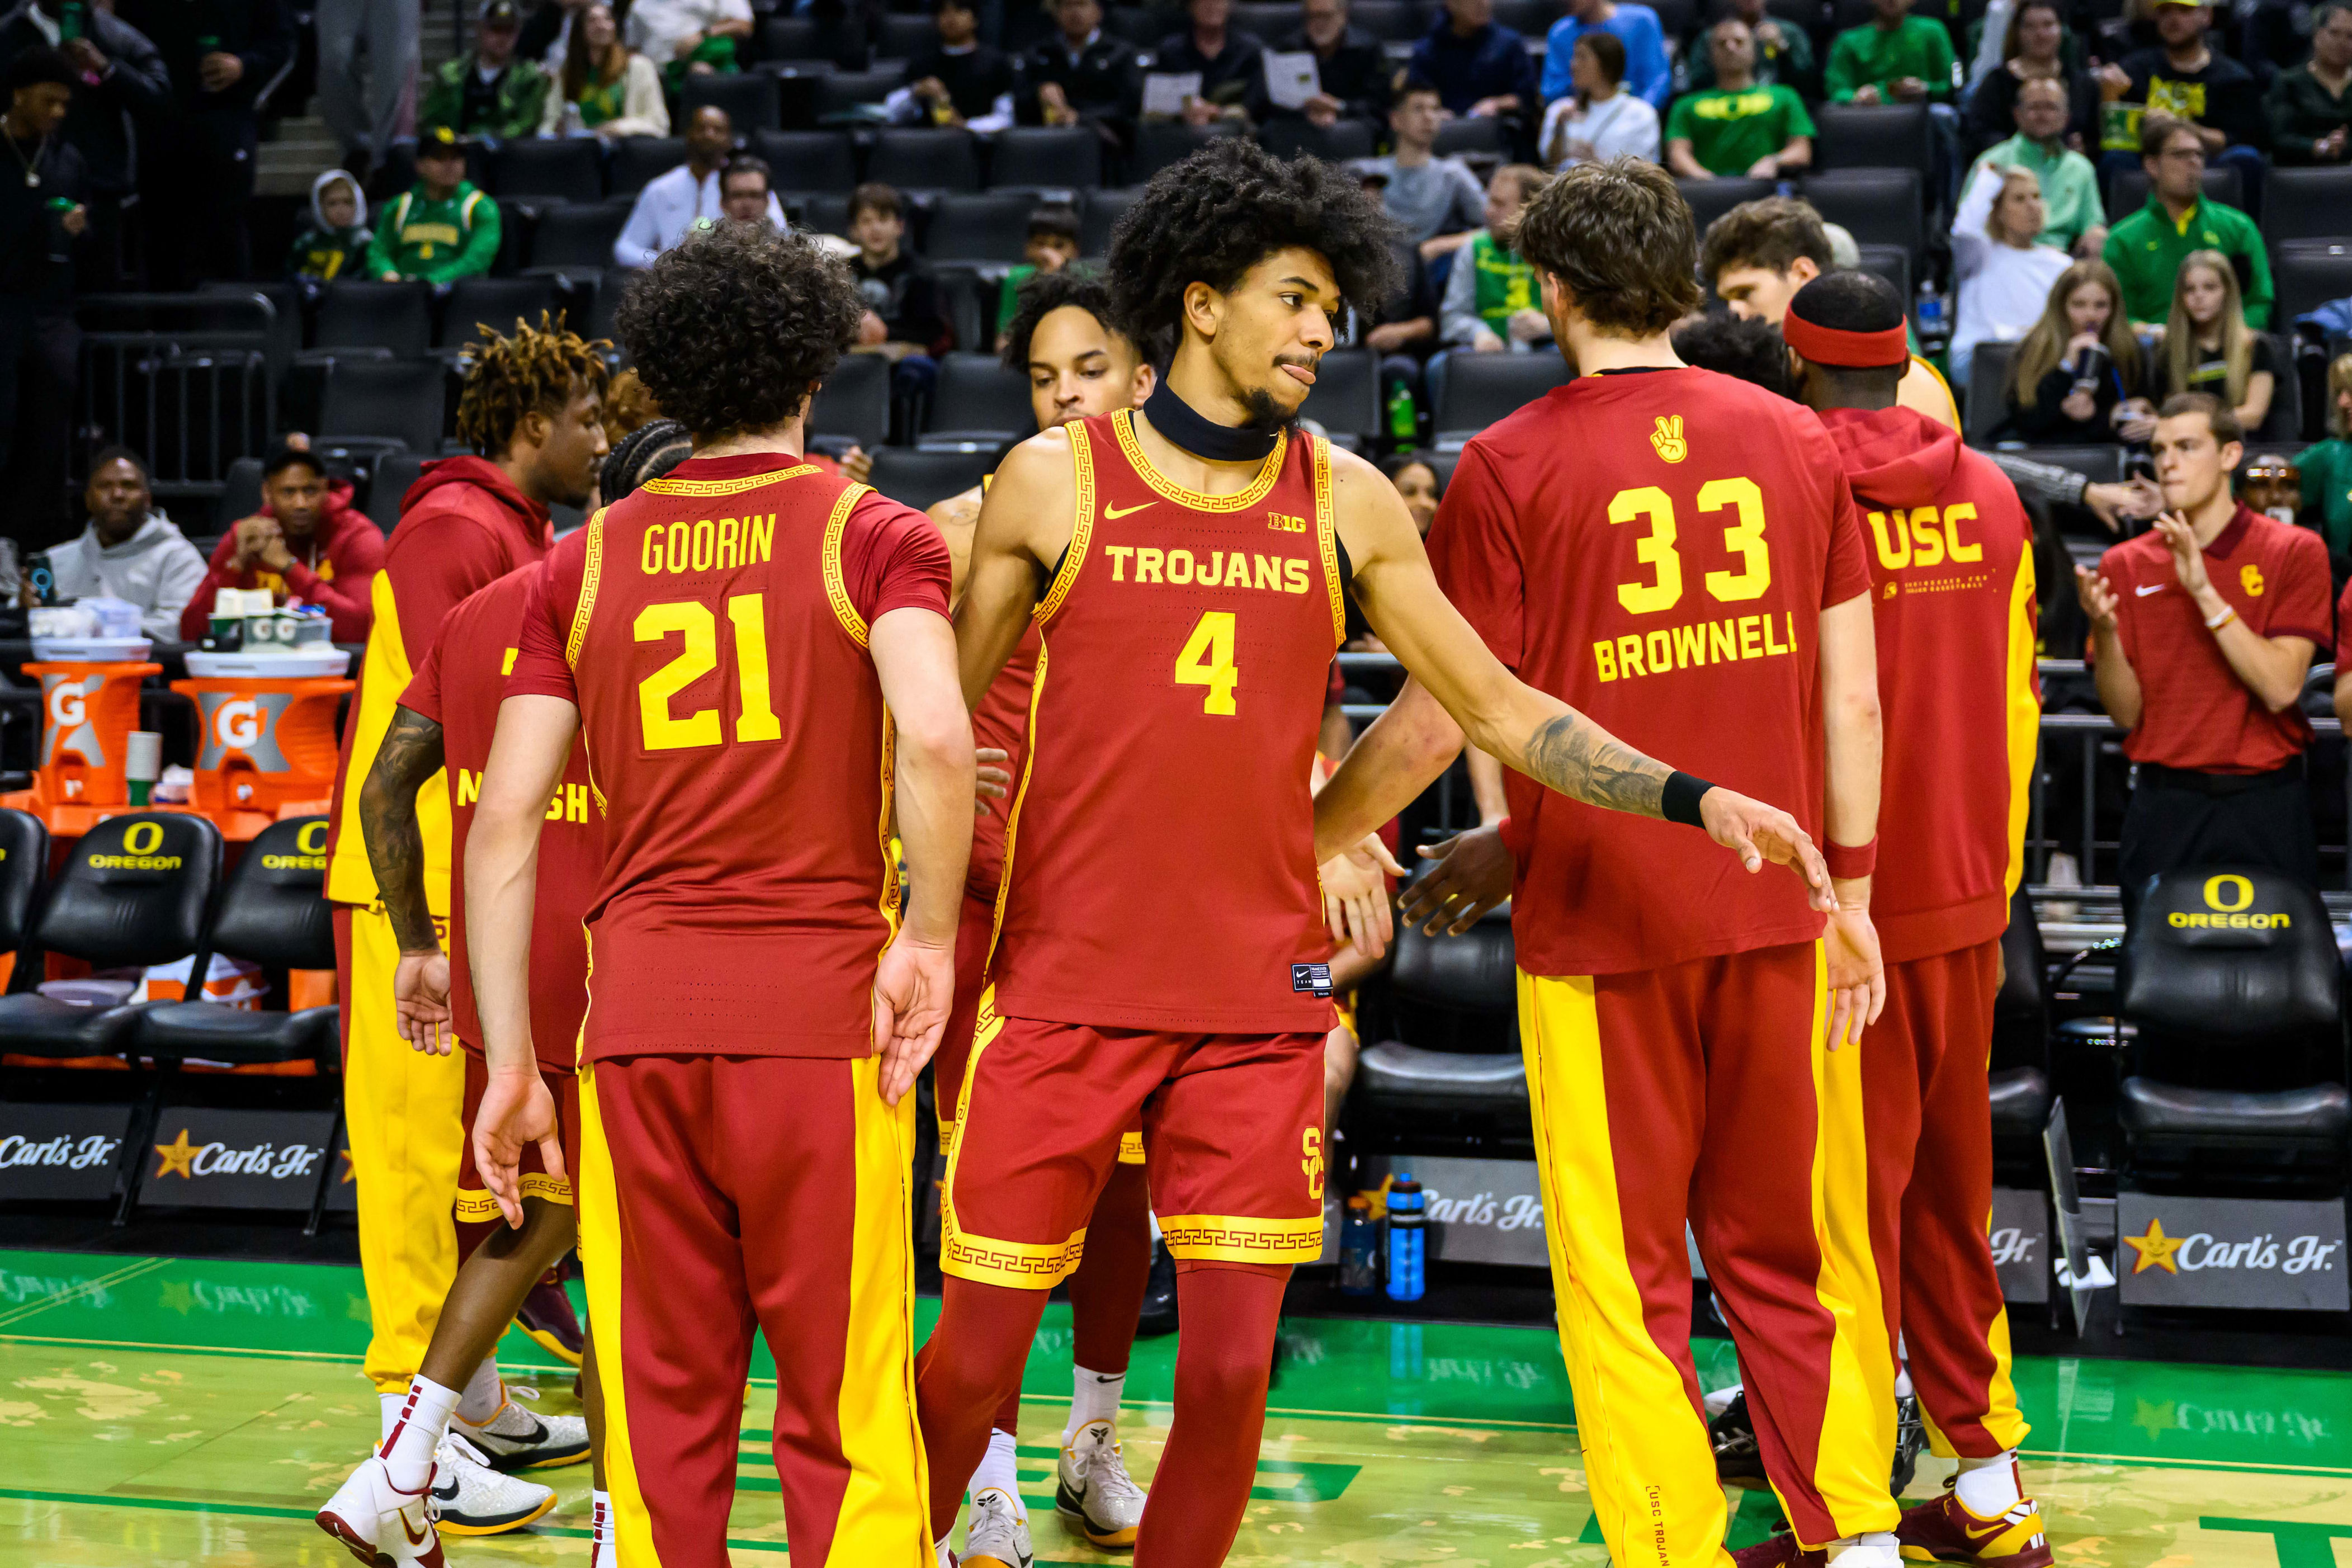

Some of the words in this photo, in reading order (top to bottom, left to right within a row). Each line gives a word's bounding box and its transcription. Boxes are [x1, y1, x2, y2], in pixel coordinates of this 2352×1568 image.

[641, 513, 777, 575] GOORIN
[1607, 476, 1771, 615] 33
[1867, 502, 1983, 570] USC
[1105, 545, 1310, 594] TROJANS
[633, 593, 782, 750] 21
[1175, 611, 1238, 716] 4
[50, 682, 86, 726] G
[218, 700, 258, 748] G
[123, 821, 164, 856] O
[88, 854, 182, 871] OREGON
[261, 854, 327, 871] OREG
[2203, 874, 2254, 913] O
[2167, 911, 2292, 929] OREGON
[0, 1134, 74, 1169] Carl's
[70, 1136, 112, 1170] Jr.
[192, 1142, 276, 1176] Carl's
[271, 1144, 317, 1179] Jr.
[1497, 1194, 1545, 1230] Jr.
[1991, 1228, 2036, 1265] Jr.
[2178, 1232, 2280, 1271] Carl's
[2282, 1235, 2336, 1274] Jr.
[1649, 1492, 1661, 1517] USC
[1654, 1521, 1670, 1566] TROJAN
